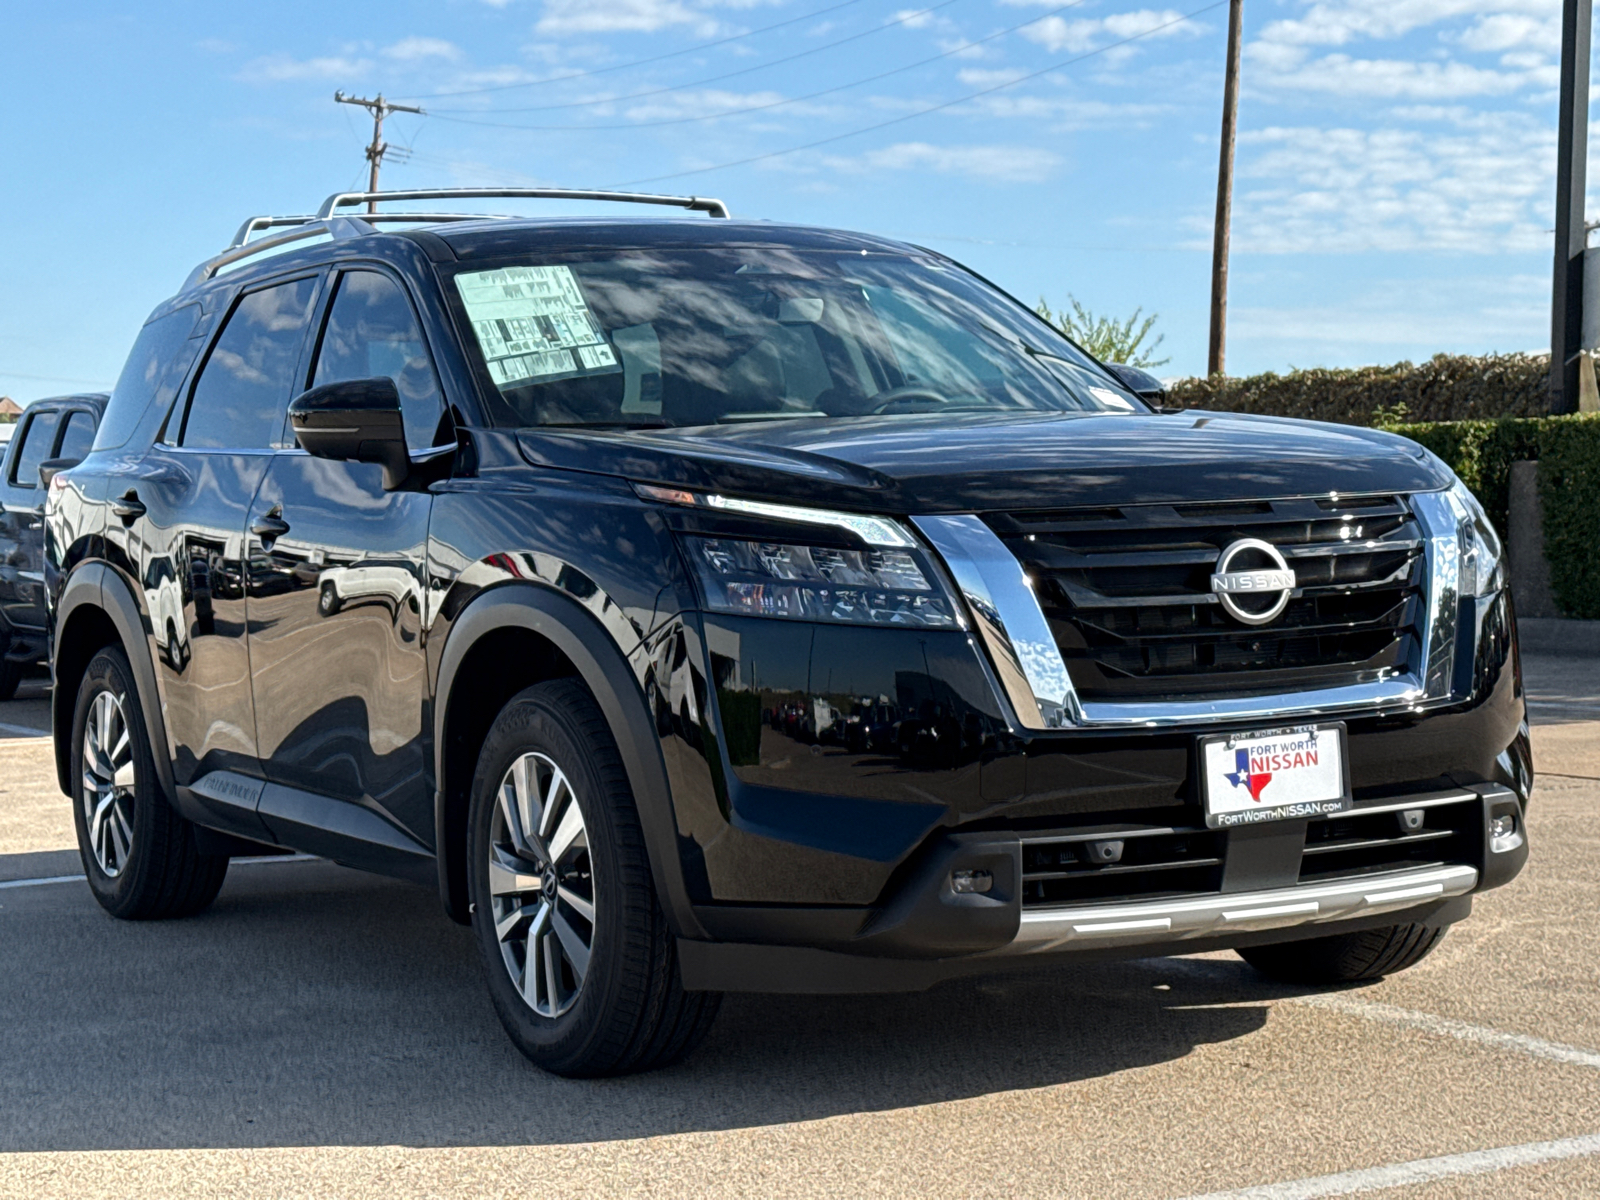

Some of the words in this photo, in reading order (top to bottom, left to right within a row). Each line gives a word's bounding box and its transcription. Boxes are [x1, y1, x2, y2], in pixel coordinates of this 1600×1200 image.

[1213, 574, 1294, 591] NISSAN
[1230, 732, 1251, 741] FORT
[1254, 728, 1282, 738] WORTH
[1294, 725, 1318, 733] TEXAS
[1250, 744, 1277, 756] FORT
[1280, 740, 1318, 753] WORTH
[1251, 750, 1319, 773] NISSAN
[204, 776, 259, 803] PATHFINDER
